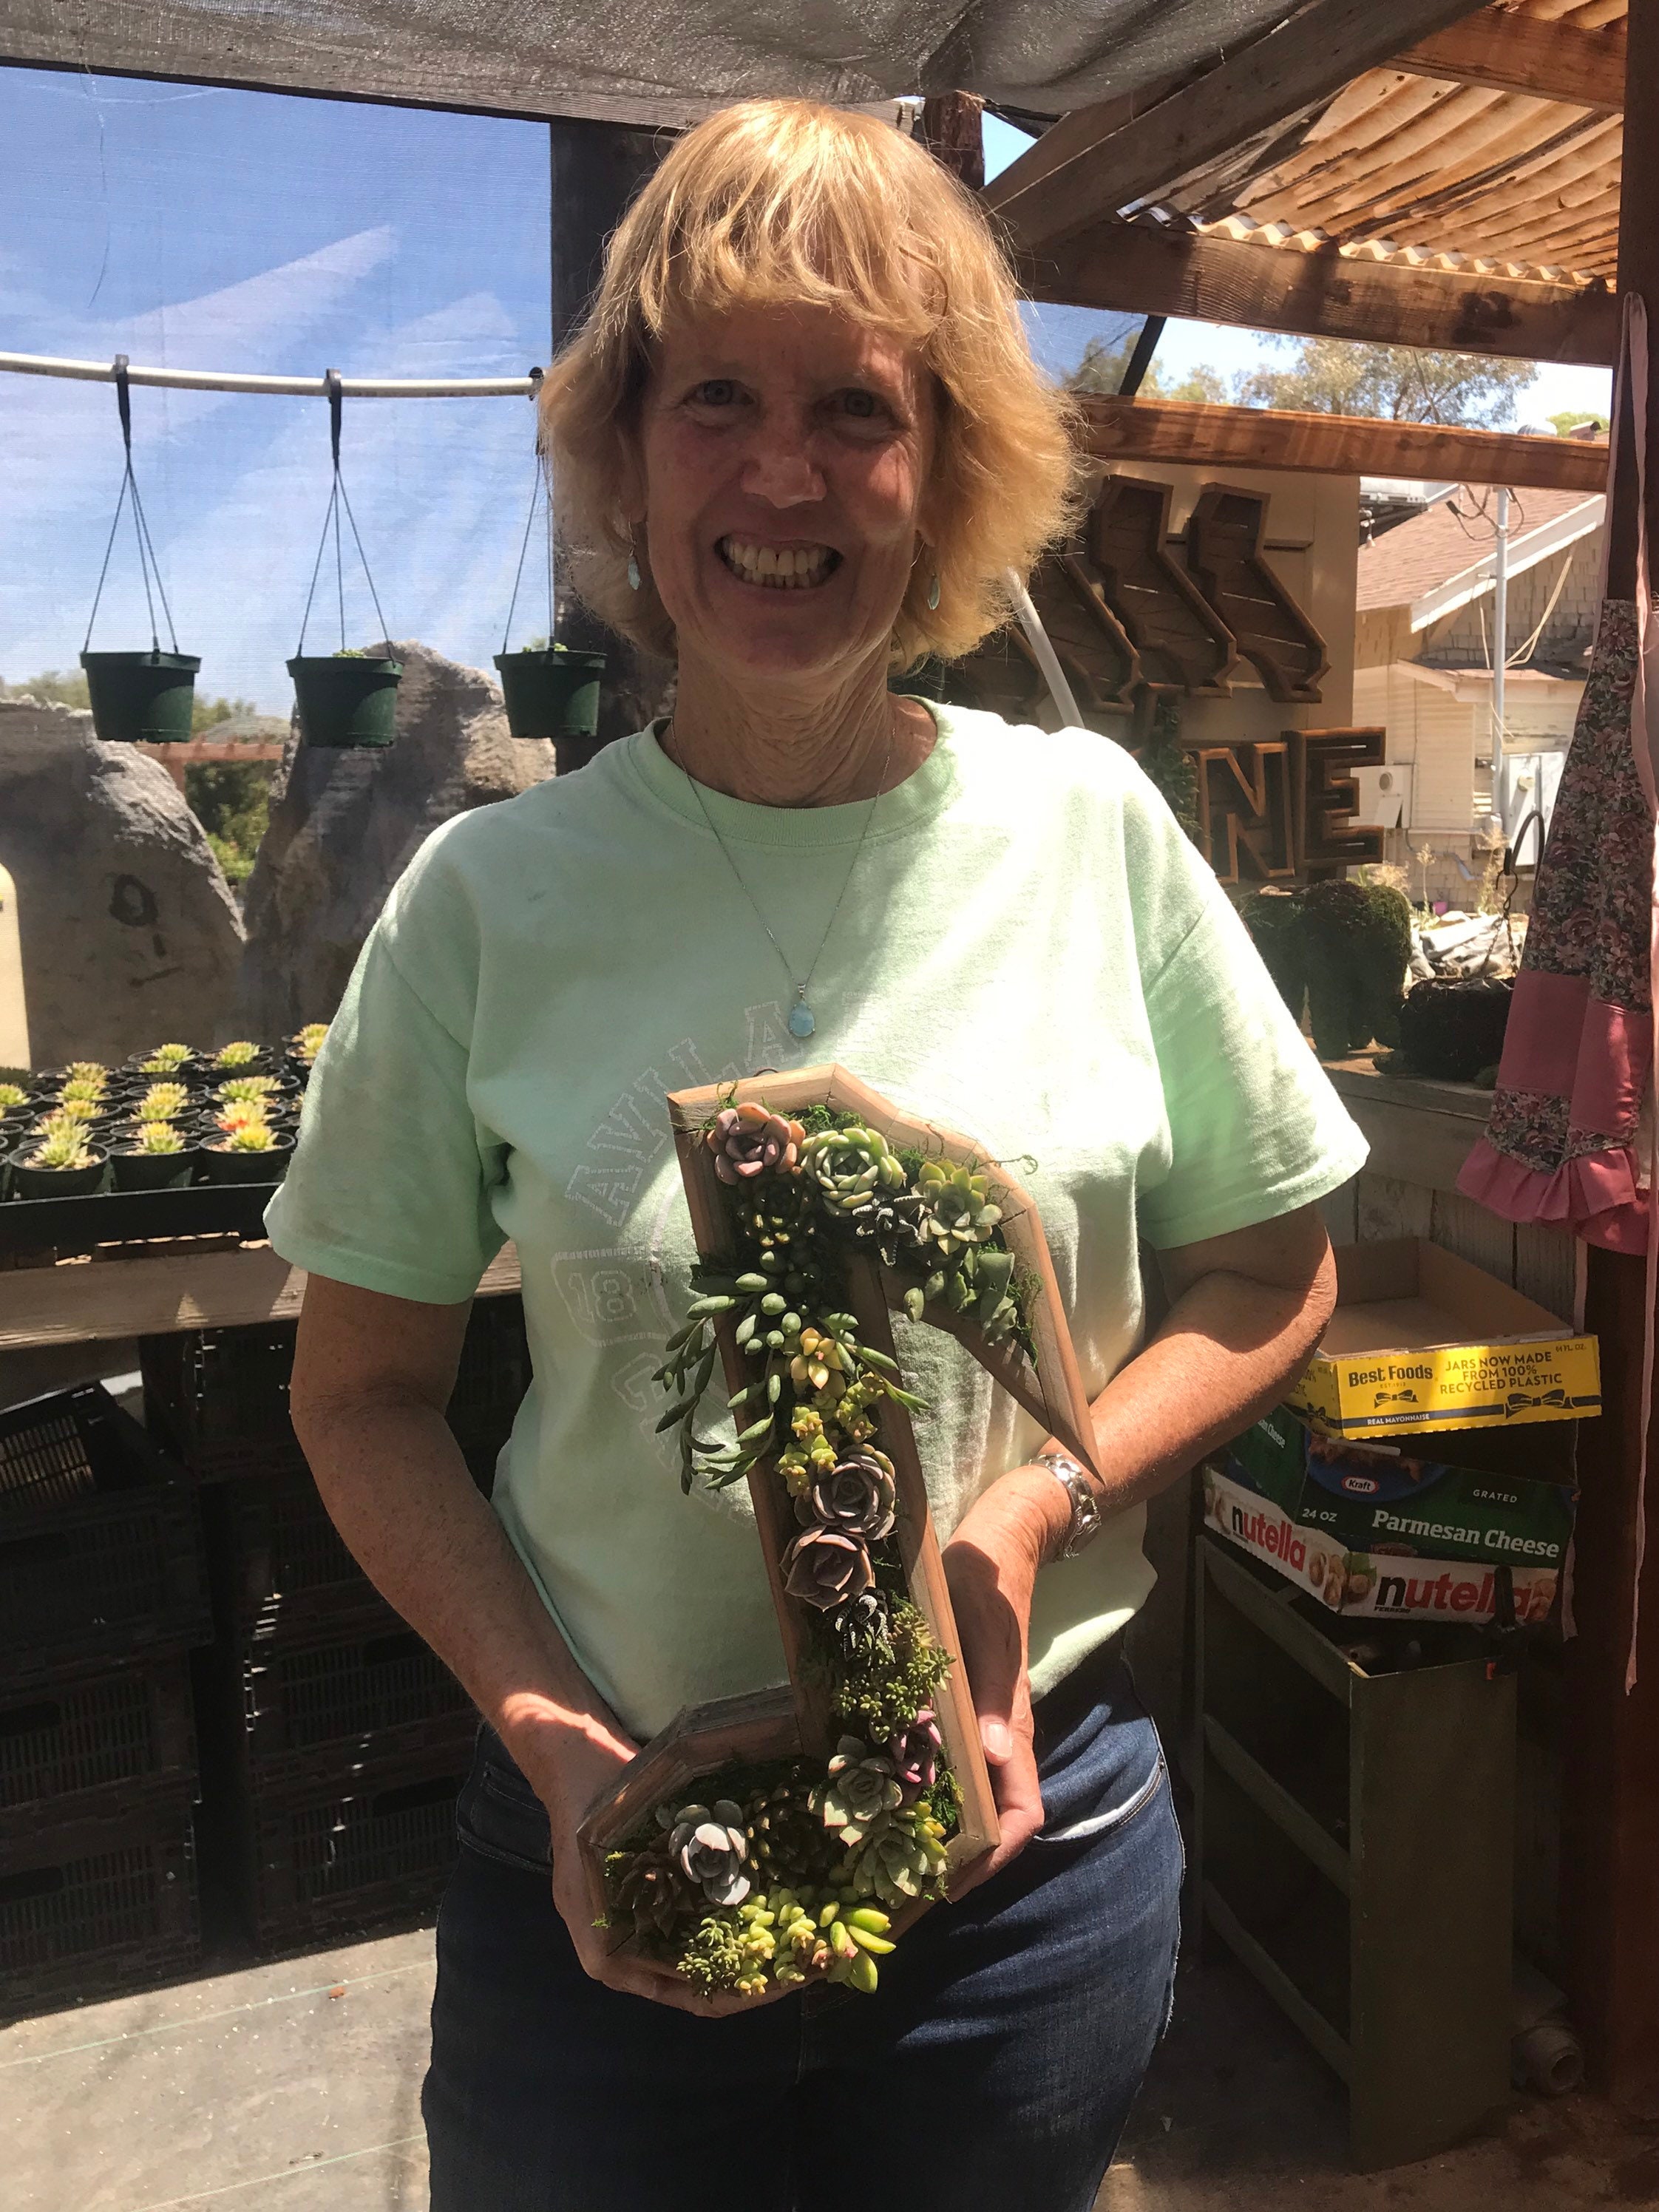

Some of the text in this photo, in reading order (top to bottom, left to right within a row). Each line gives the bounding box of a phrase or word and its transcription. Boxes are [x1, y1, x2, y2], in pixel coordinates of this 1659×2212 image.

[1445, 1351, 1553, 1371] JARS NOW MADE
[1348, 1367, 1386, 1387] Best
[1388, 1364, 1433, 1380] Foods
[1462, 1365, 1537, 1381] FROM 100%
[1440, 1373, 1562, 1394] RECYCLED PLASTIC
[1367, 1414, 1430, 1425] REAL MAYONNAISE
[1348, 1479, 1371, 1490] Kraft
[1473, 1489, 1518, 1504] GRATED
[1302, 1508, 1337, 1522] 24 OZ
[1232, 1505, 1306, 1572] nutella
[1371, 1510, 1560, 1558] Parmesan Cheese
[1375, 1573, 1533, 1615] nutela
